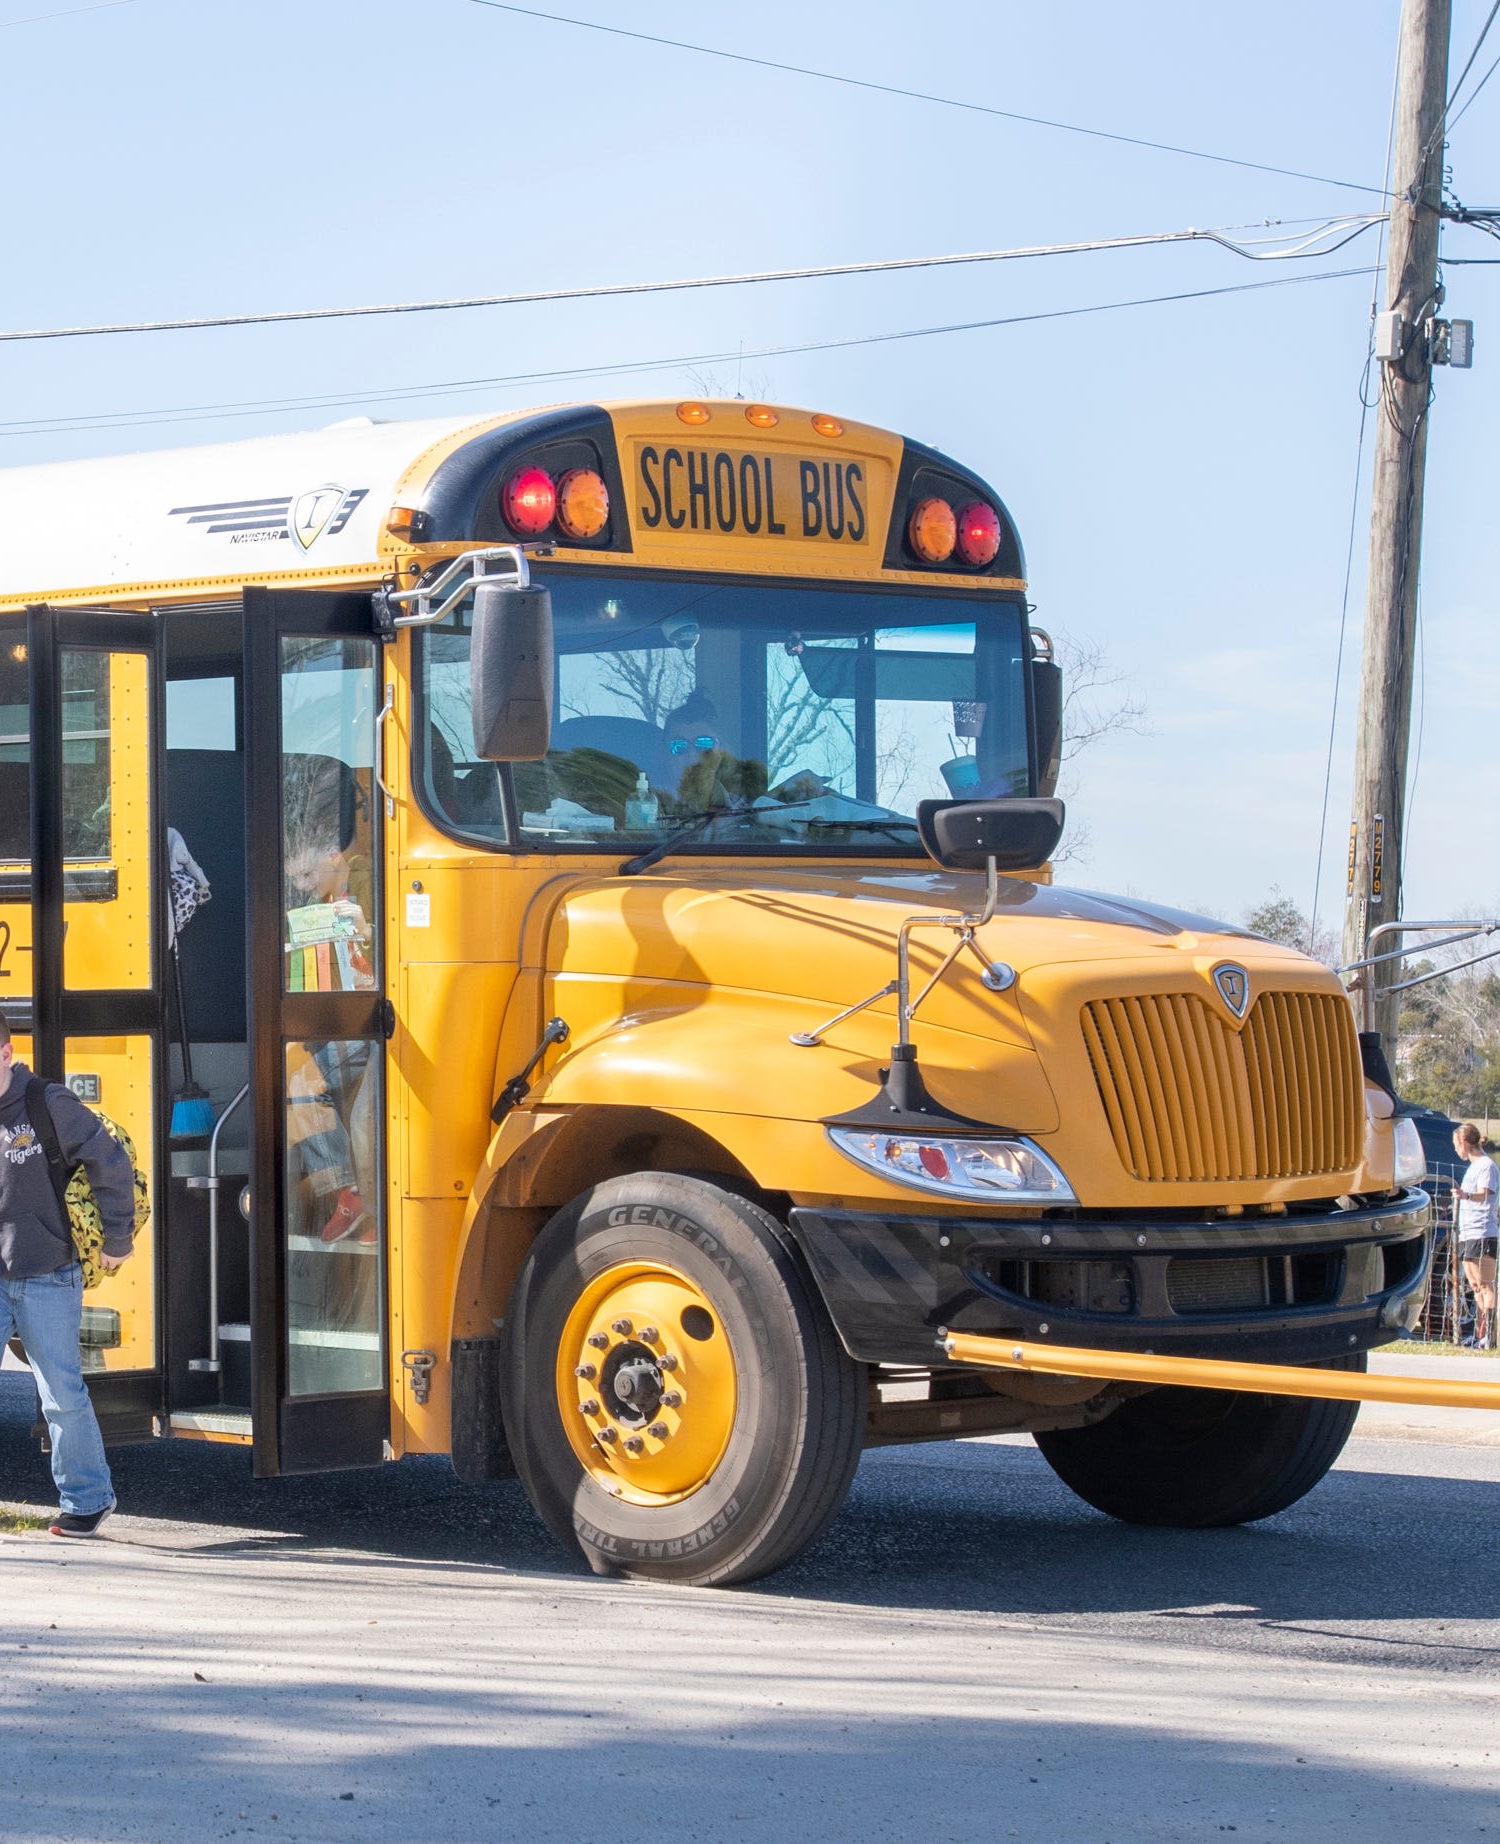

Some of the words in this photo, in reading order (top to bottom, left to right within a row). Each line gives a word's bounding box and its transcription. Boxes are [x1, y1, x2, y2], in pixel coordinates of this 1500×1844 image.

[640, 446, 786, 535] SCHOOL
[800, 460, 865, 542] BUS
[230, 530, 280, 544] NAVISTAR
[1373, 821, 1382, 893] M2779
[4, 1143, 42, 1165] Tigers
[608, 1205, 750, 1294] GENERAL
[631, 1497, 741, 1558] GENERAL
